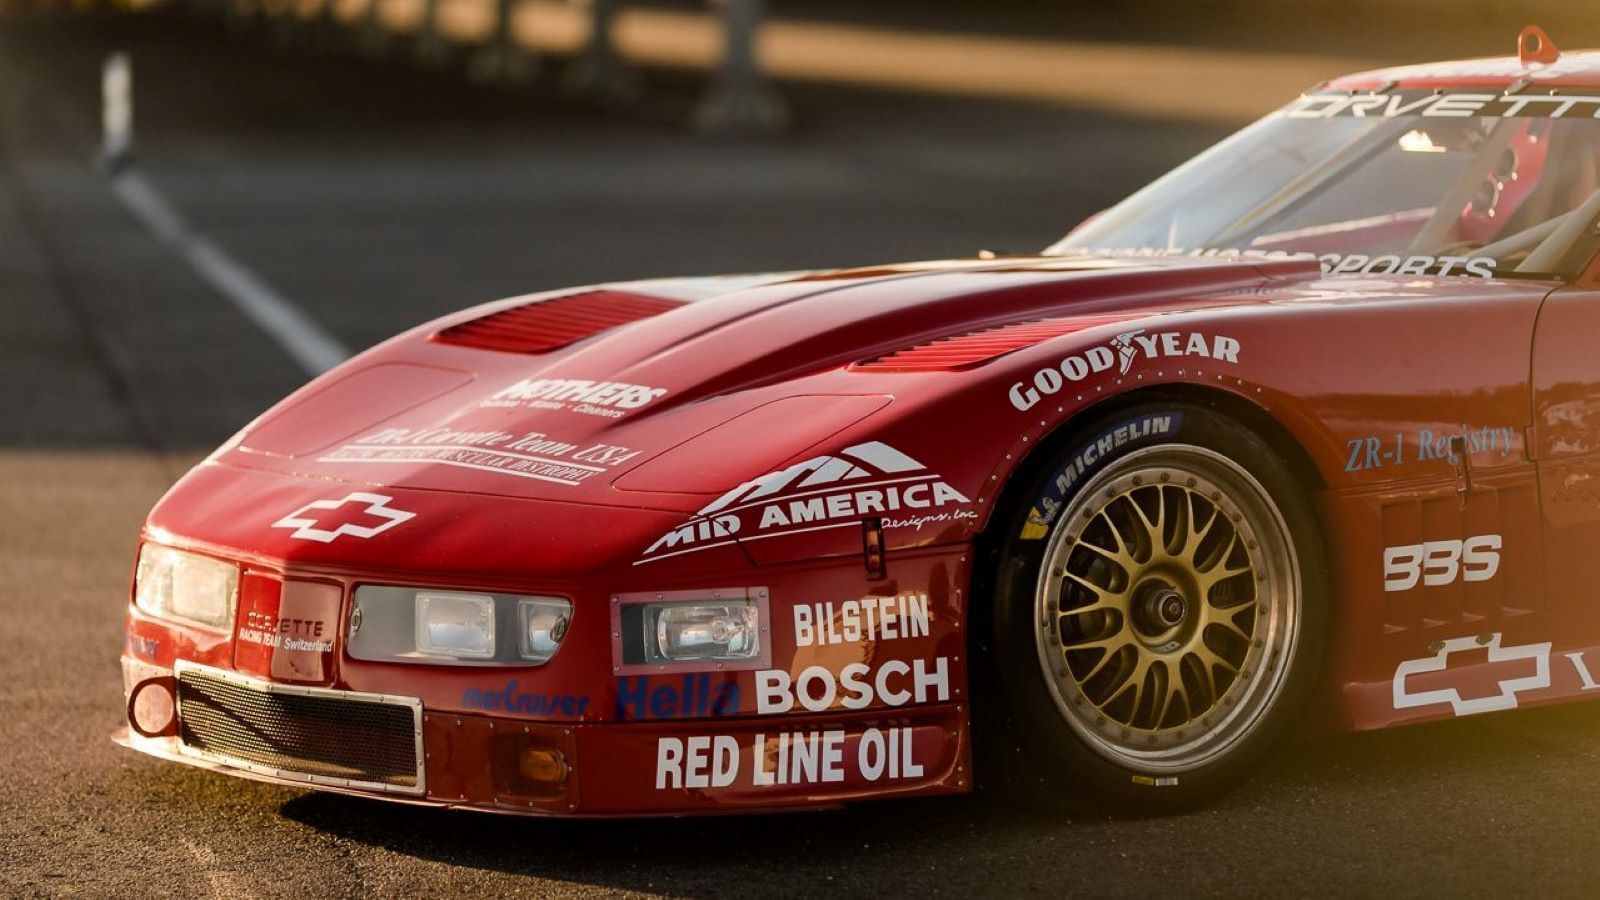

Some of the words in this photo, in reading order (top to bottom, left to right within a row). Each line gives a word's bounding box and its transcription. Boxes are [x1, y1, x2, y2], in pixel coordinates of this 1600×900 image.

[1286, 93, 1600, 118] ORVETT
[490, 379, 669, 409] MOTHERS
[422, 428, 513, 446] Corvette
[504, 432, 578, 457] Team
[572, 444, 645, 466] USA
[1055, 416, 1172, 496] MICHELIN
[1344, 432, 1405, 473] ZR-1
[1416, 423, 1514, 465] Registry
[643, 515, 741, 554] MID
[759, 482, 971, 529] AMERICA
[1383, 535, 1502, 592] BBS
[239, 628, 262, 644] RACING
[262, 632, 282, 648] TEAM
[284, 637, 334, 652] Switzerland
[248, 611, 325, 637] CORETTE
[793, 594, 930, 647] BILSTEIN
[615, 673, 741, 720] Hella
[755, 656, 950, 715] BOSCH
[655, 735, 740, 790] RED
[752, 730, 845, 787] LINE
[858, 727, 924, 782] OIL
